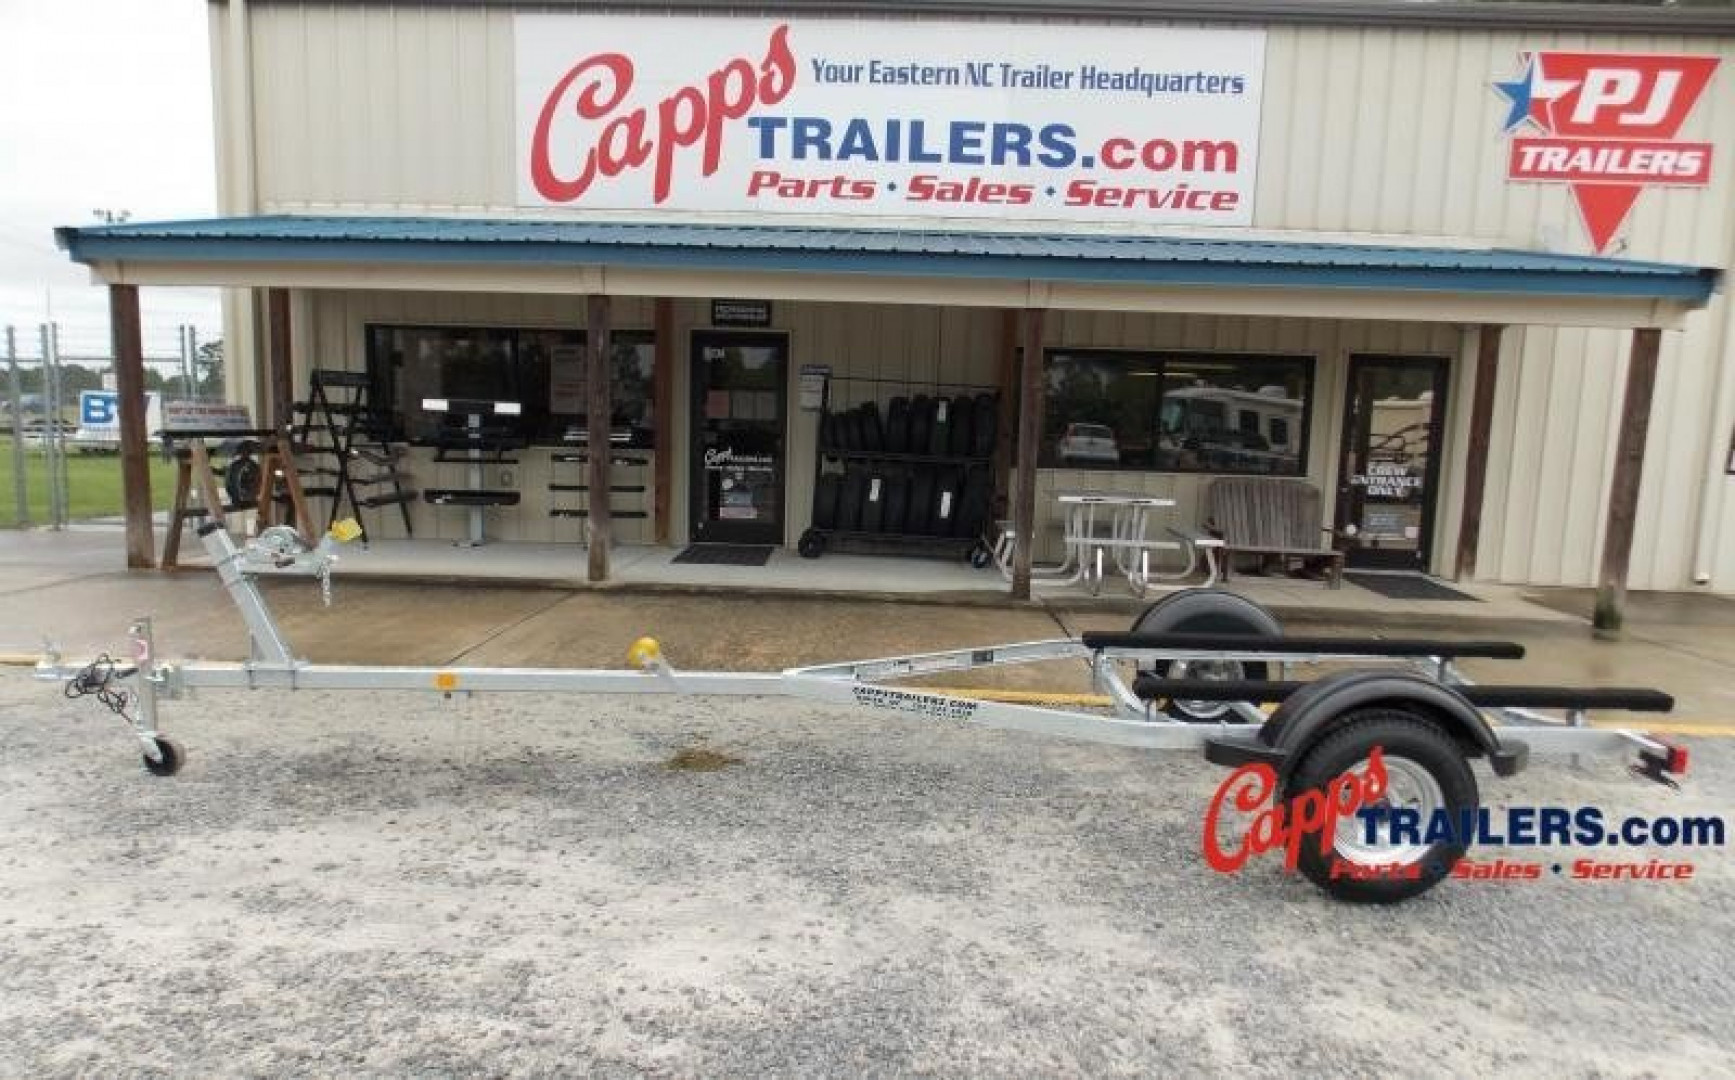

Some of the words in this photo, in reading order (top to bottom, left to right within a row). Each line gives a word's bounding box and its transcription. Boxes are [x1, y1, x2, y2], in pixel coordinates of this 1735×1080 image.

[812, 58, 864, 85] Your
[869, 60, 960, 87] Eastern
[964, 62, 994, 88] NC
[1000, 63, 1075, 91] Trailer
[1080, 67, 1244, 98] Headquarters
[1570, 69, 1684, 126] PJ
[531, 24, 797, 203] Capps
[748, 115, 1239, 174] TRAILERS.com
[1519, 146, 1706, 177] TRAILERS
[747, 171, 876, 200] Parts
[906, 175, 1035, 205] Sales
[1064, 179, 1240, 212] Service
